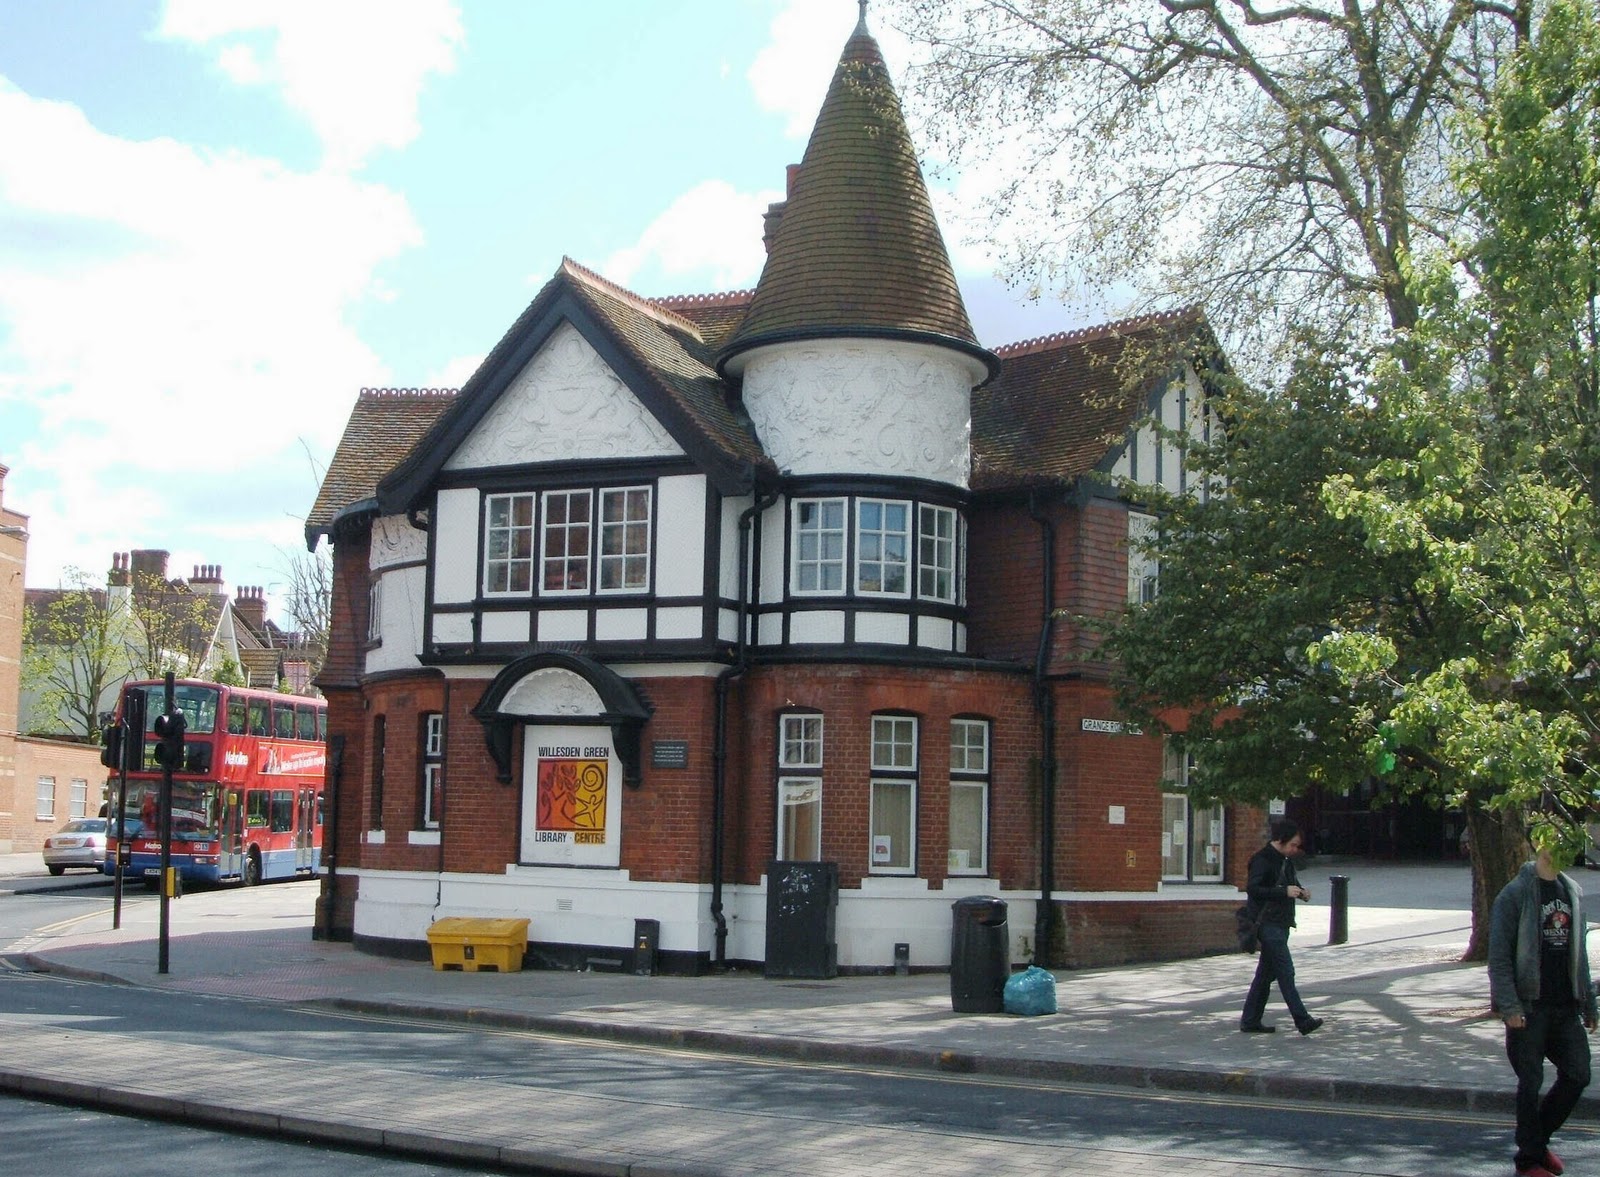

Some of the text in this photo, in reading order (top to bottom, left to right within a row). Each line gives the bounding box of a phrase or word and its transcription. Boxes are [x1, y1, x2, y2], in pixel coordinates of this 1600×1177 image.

[1084, 720, 1109, 731] GRANGE
[538, 746, 610, 758] WILLESDEN GREEN
[535, 832, 606, 844] LIBRARY CENTRE
